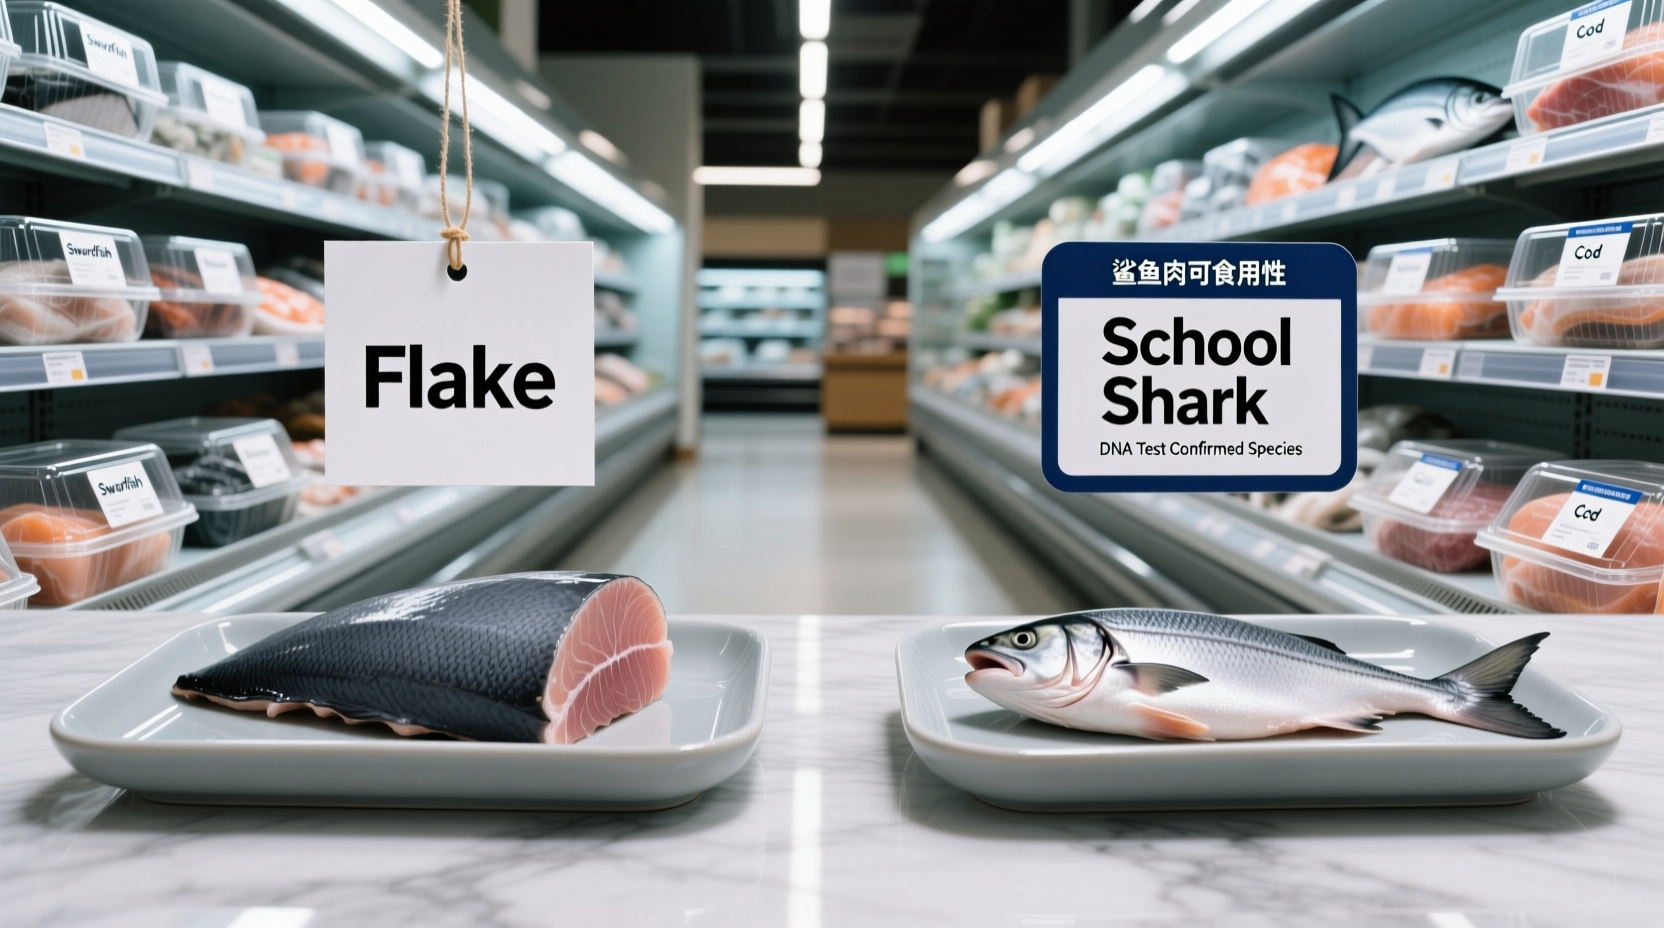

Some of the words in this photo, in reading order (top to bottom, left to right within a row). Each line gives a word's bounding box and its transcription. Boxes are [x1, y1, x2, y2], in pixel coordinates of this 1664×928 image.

[1576, 18, 1605, 39] Cod
[1574, 243, 1604, 260] Cod
[1112, 258, 1287, 287] 鲨鱼肉可食用性
[1102, 316, 1291, 366] School
[365, 344, 556, 410] Flake
[1101, 376, 1269, 426] Shark
[1099, 441, 1133, 456] DNA
[1136, 441, 1166, 456] Test
[1169, 440, 1244, 456] Confirmed
[1248, 441, 1303, 459] Species
